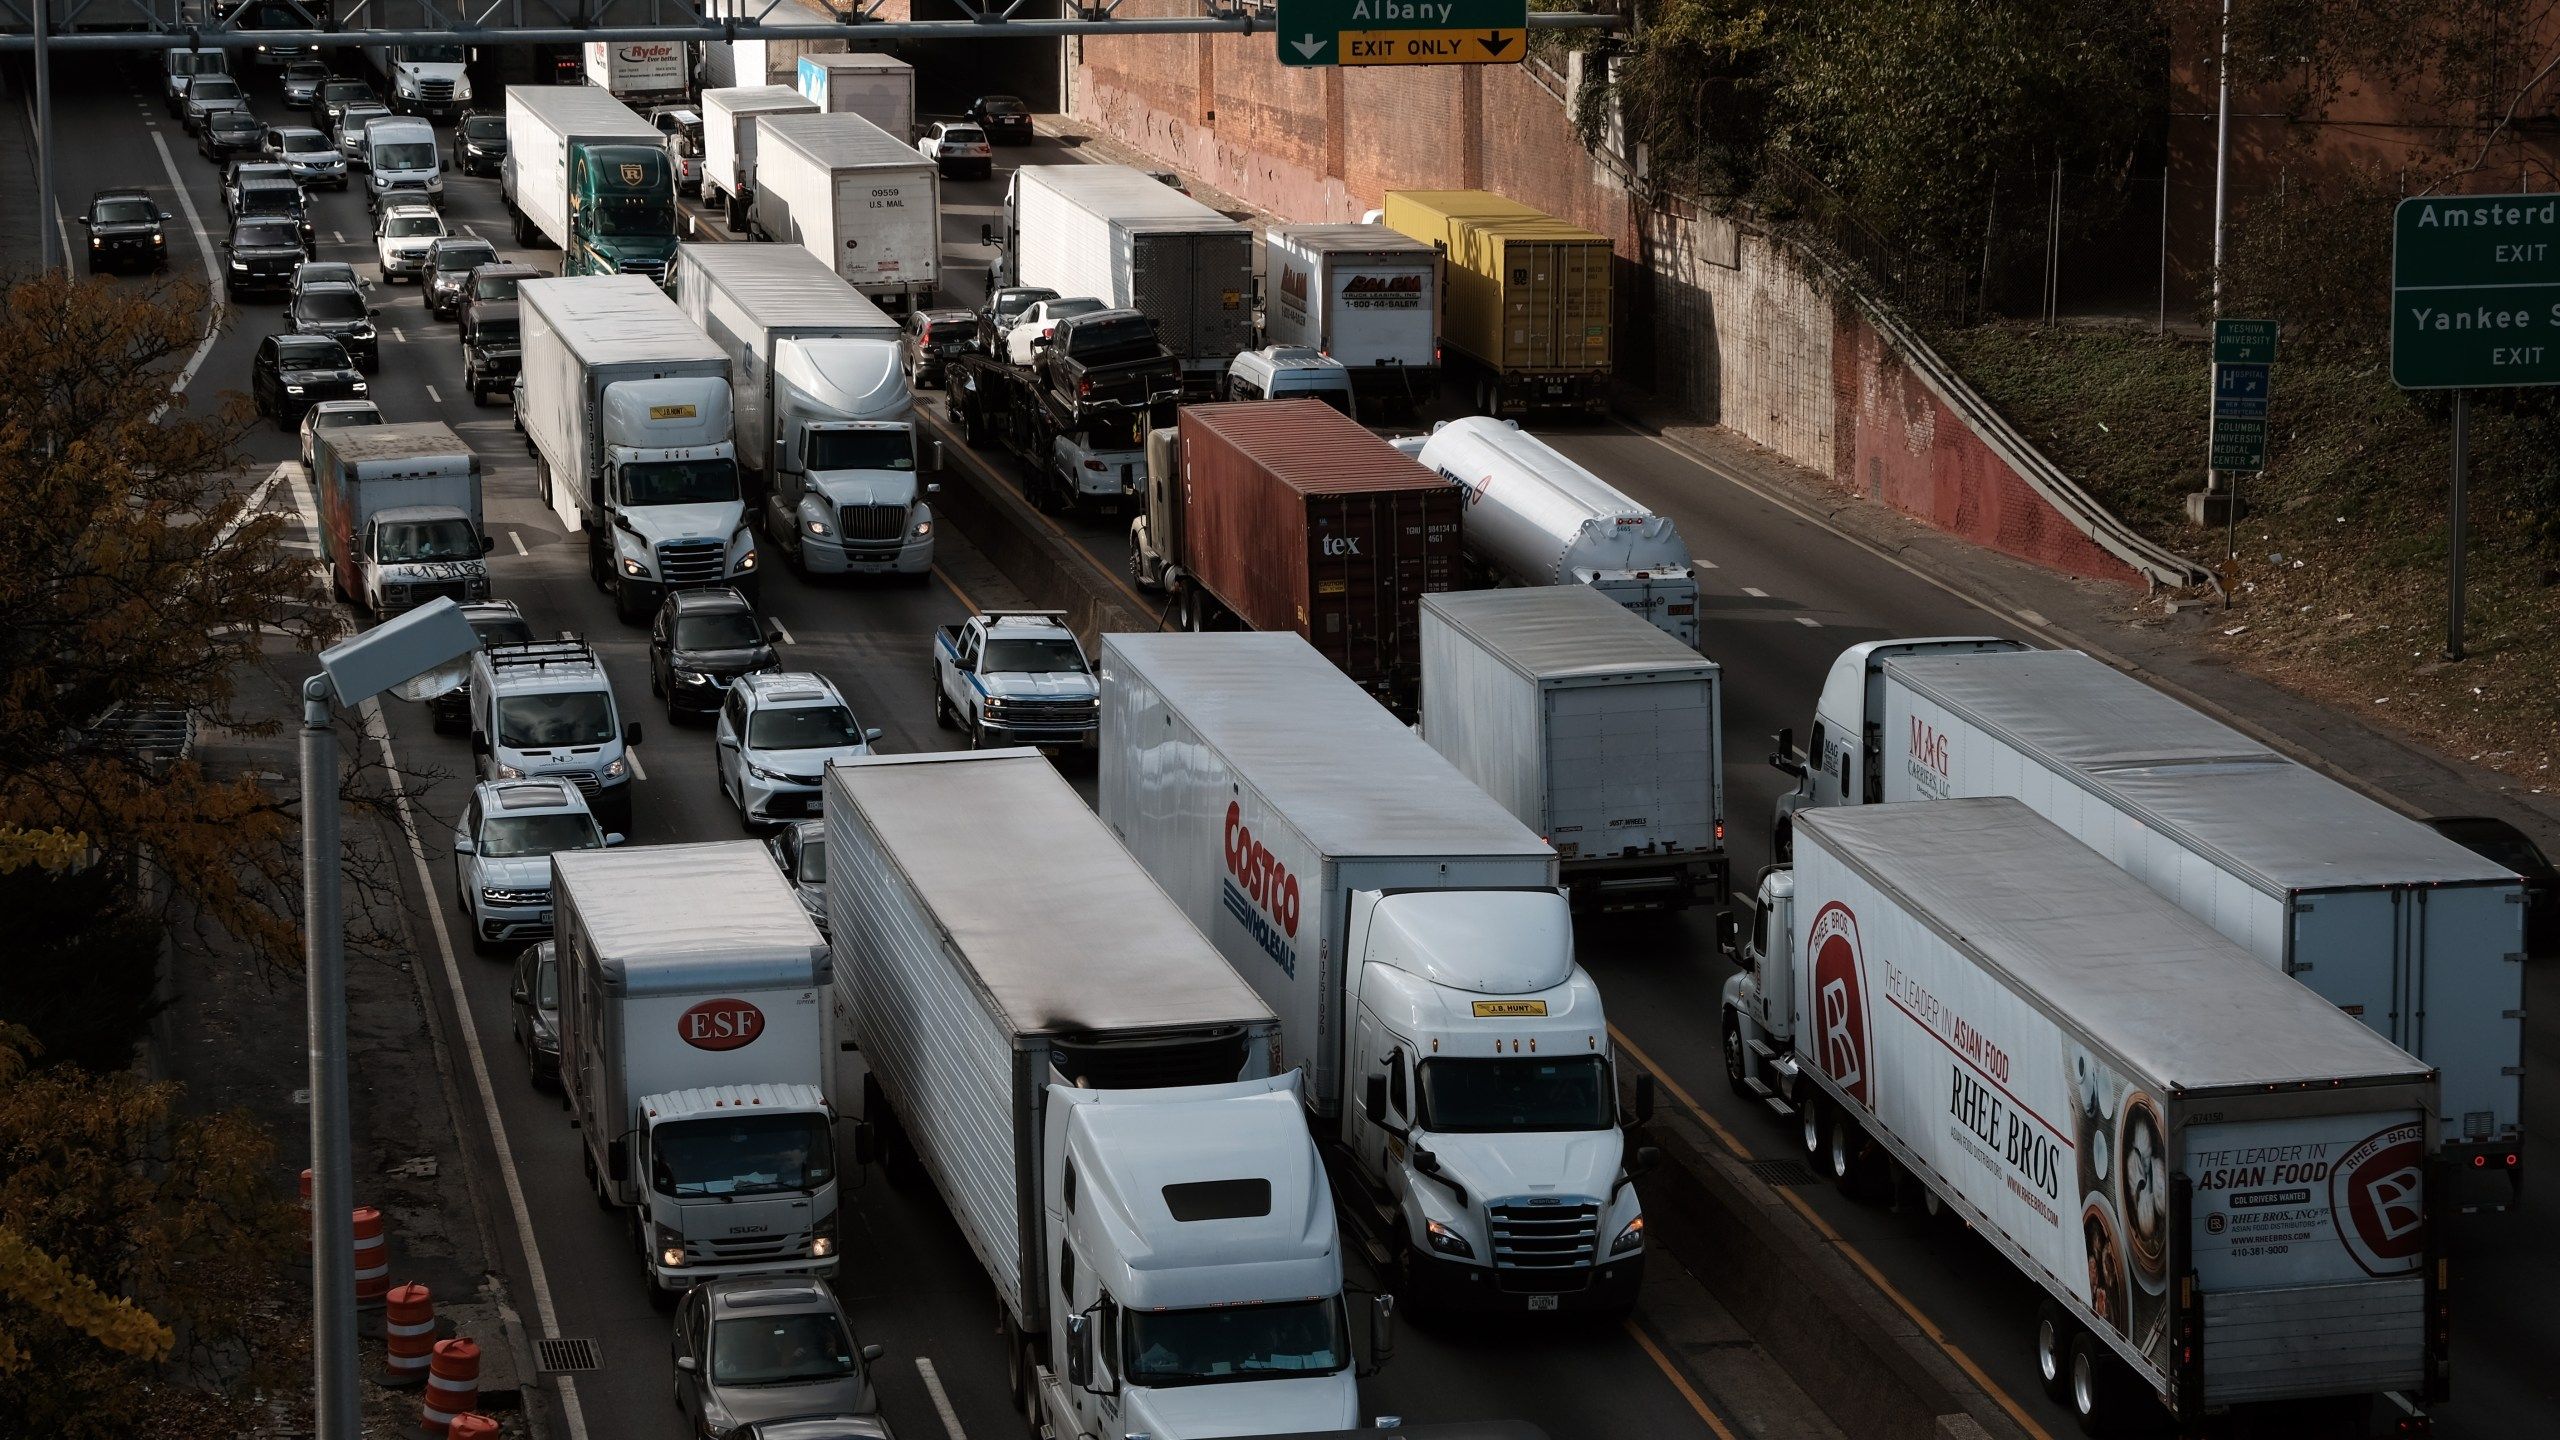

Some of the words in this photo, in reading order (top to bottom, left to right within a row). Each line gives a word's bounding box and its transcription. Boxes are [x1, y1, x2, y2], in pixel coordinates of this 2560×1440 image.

[1352, 0, 1452, 23] Albany
[632, 45, 672, 58] Ryder
[1352, 41, 1394, 56] EXIT
[1408, 39, 1462, 55] ONLY
[872, 189, 899, 197] 09559
[2418, 201, 2555, 228] Amsterd
[2496, 244, 2547, 262] EXIT
[2412, 306, 2530, 331] Yankee
[2229, 324, 2264, 333] YESHIVA
[2220, 335, 2271, 344] UNIVERSITY
[2492, 347, 2544, 365] EXIT
[2218, 422, 2261, 432] COLUMBIA
[2214, 434, 2264, 444] UNIVERSITY
[2213, 445, 2250, 454] MEDICAL
[2213, 455, 2246, 465] CENTER
[1322, 533, 1361, 556] tex
[1909, 714, 1948, 777] MAG
[1225, 800, 1299, 939] COSTCO
[1244, 901, 1296, 982] WHOLESALE
[1814, 916, 1829, 953] RHEE
[688, 1009, 756, 1040] ESF
[1885, 960, 1902, 998] THE
[1904, 975, 1939, 1027] LEADER
[1942, 1005, 1953, 1038] IN
[1953, 1016, 1982, 1063] ASIAN
[1985, 1039, 2009, 1084] FOOD
[1950, 1064, 2002, 1152] RHEE
[2006, 1109, 2060, 1201] BROS
[2198, 1151, 2231, 1167] THE
[2236, 1145, 2302, 1165] LEADER
[2308, 1143, 2327, 1160] IN
[2346, 1140, 2379, 1170] RHEE
[2198, 1166, 2266, 1190] ASIAN
[2272, 1162, 2328, 1185] FOOD
[2234, 1196, 2248, 1204] CDL
[2249, 1194, 2278, 1203] DRIVERS
[2279, 1192, 2306, 1201] WANTED
[2231, 1212, 2260, 1224] RHEE
[2231, 1225, 2251, 1233] ASIAN
[2271, 1221, 2315, 1230] DISTRIBUTORS
[729, 1225, 768, 1234] ISUZU
[2231, 1233, 2310, 1244] WWW.RHEEBROS.COM
